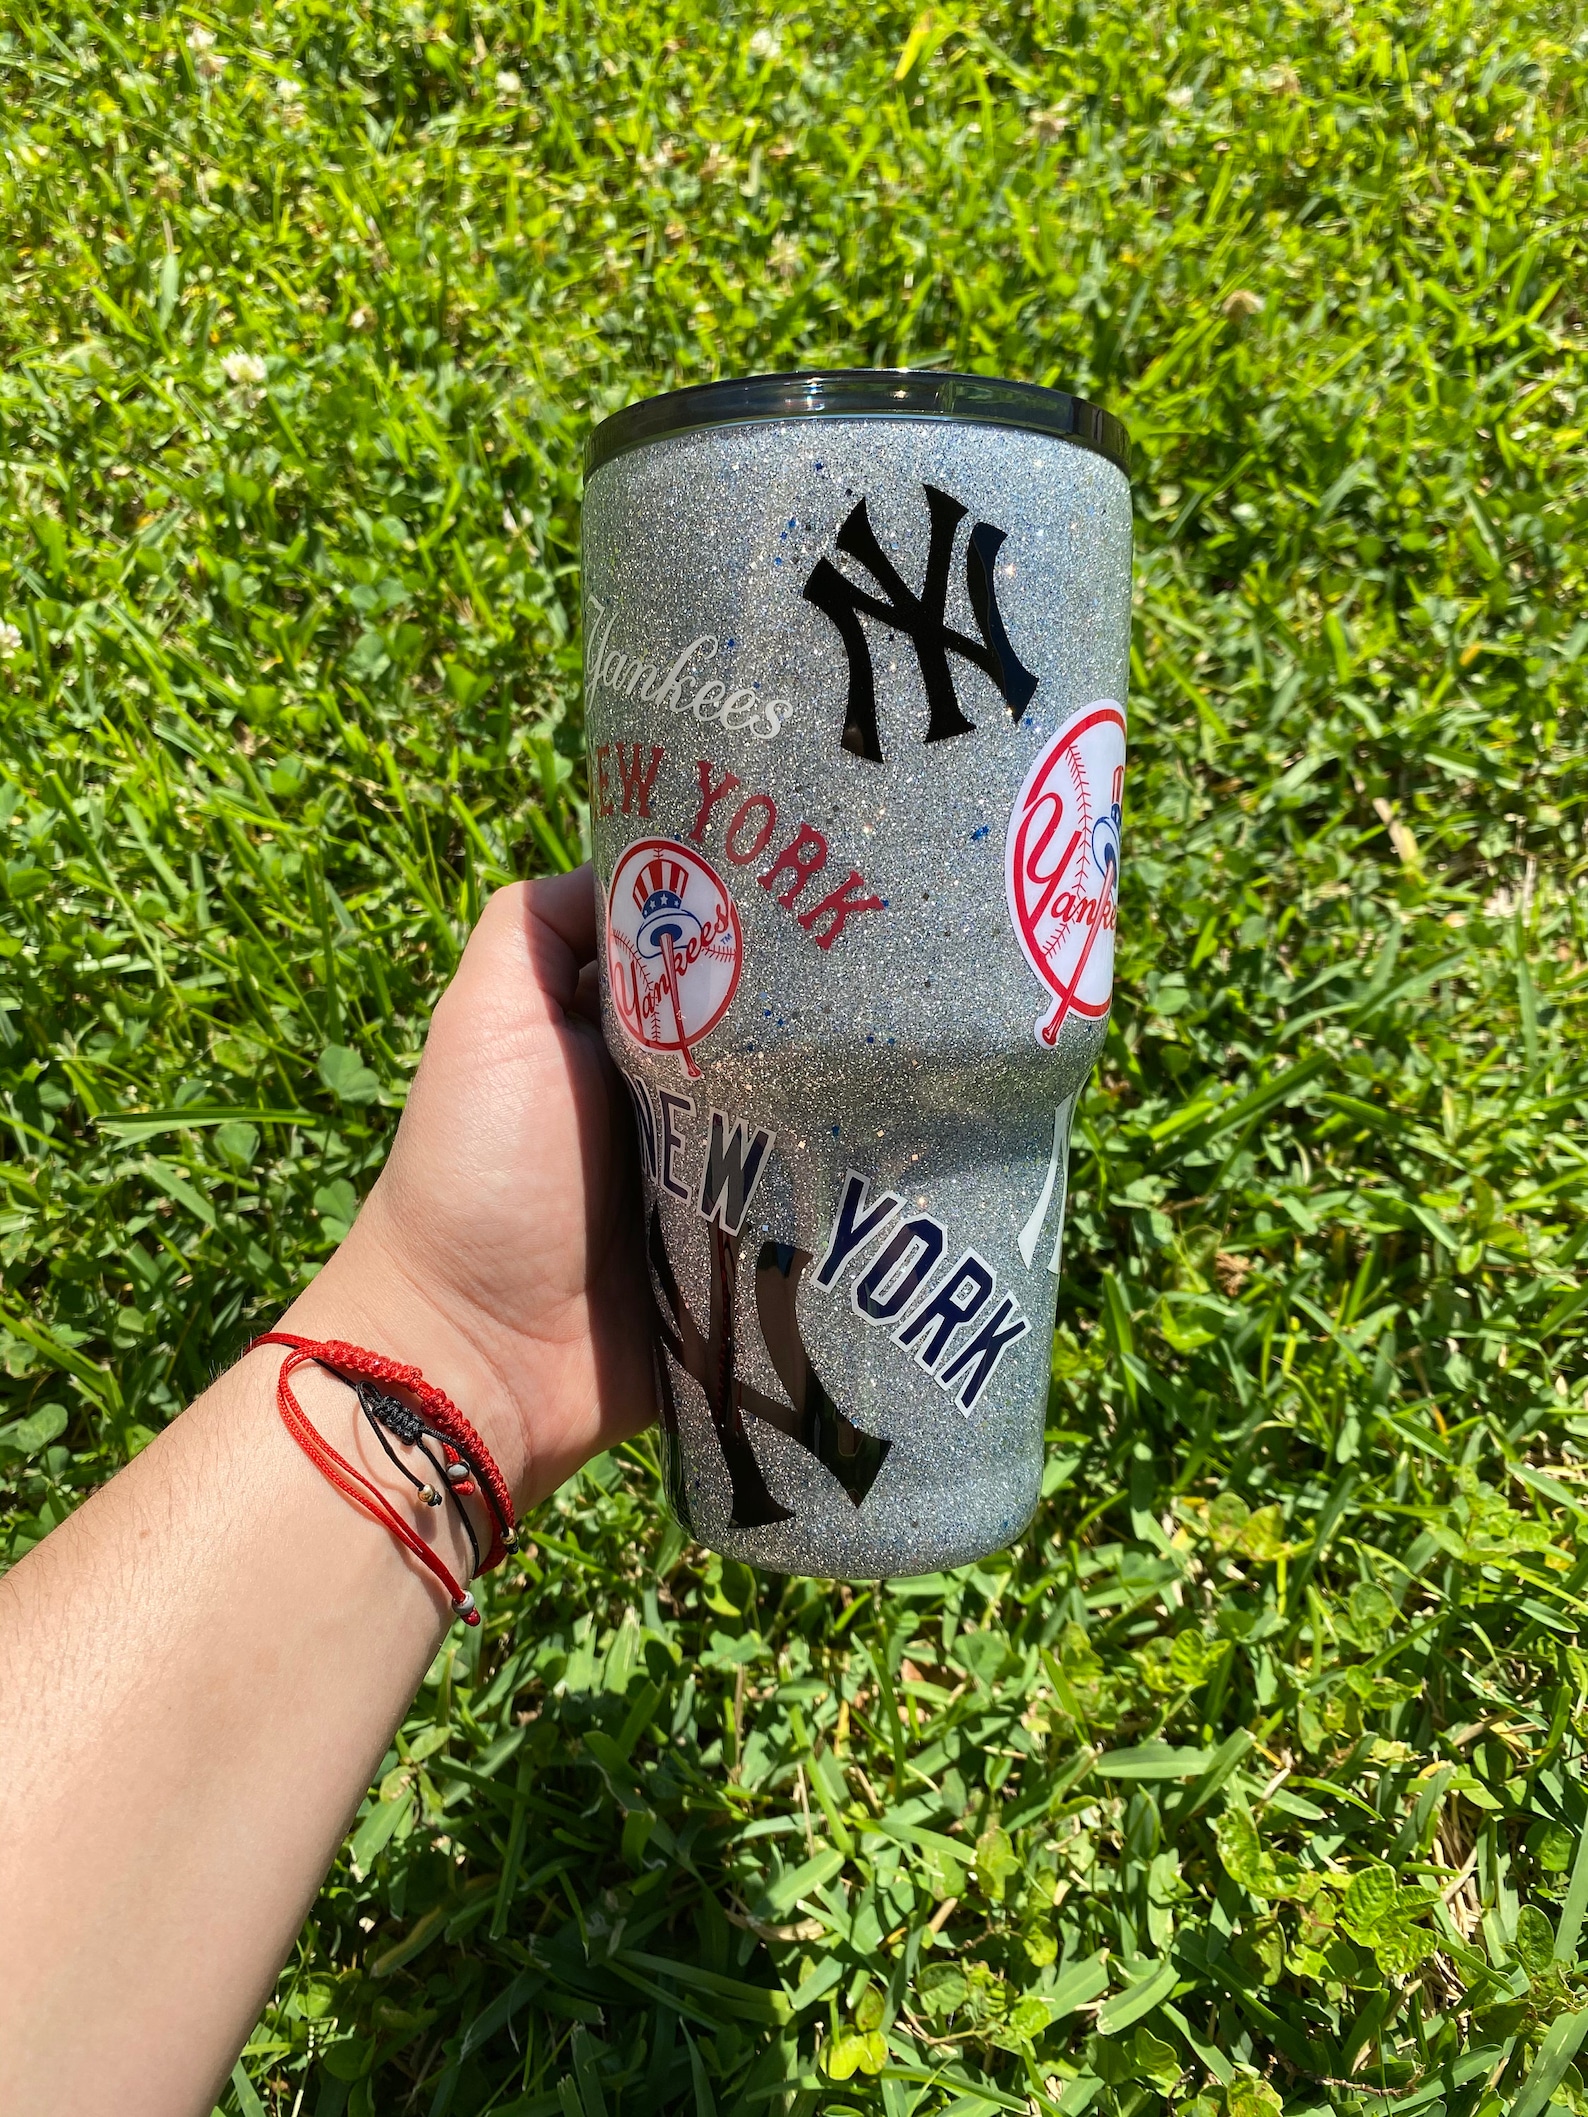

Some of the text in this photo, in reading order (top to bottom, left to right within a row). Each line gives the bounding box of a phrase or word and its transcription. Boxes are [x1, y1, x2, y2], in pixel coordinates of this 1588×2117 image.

[585, 594, 794, 740] Yankees
[595, 741, 885, 951] EW YORK
[1020, 791, 1118, 933] Yanke
[613, 902, 730, 1040] Yankees
[624, 1068, 777, 1238] NEW
[810, 1168, 1033, 1418] YORK
